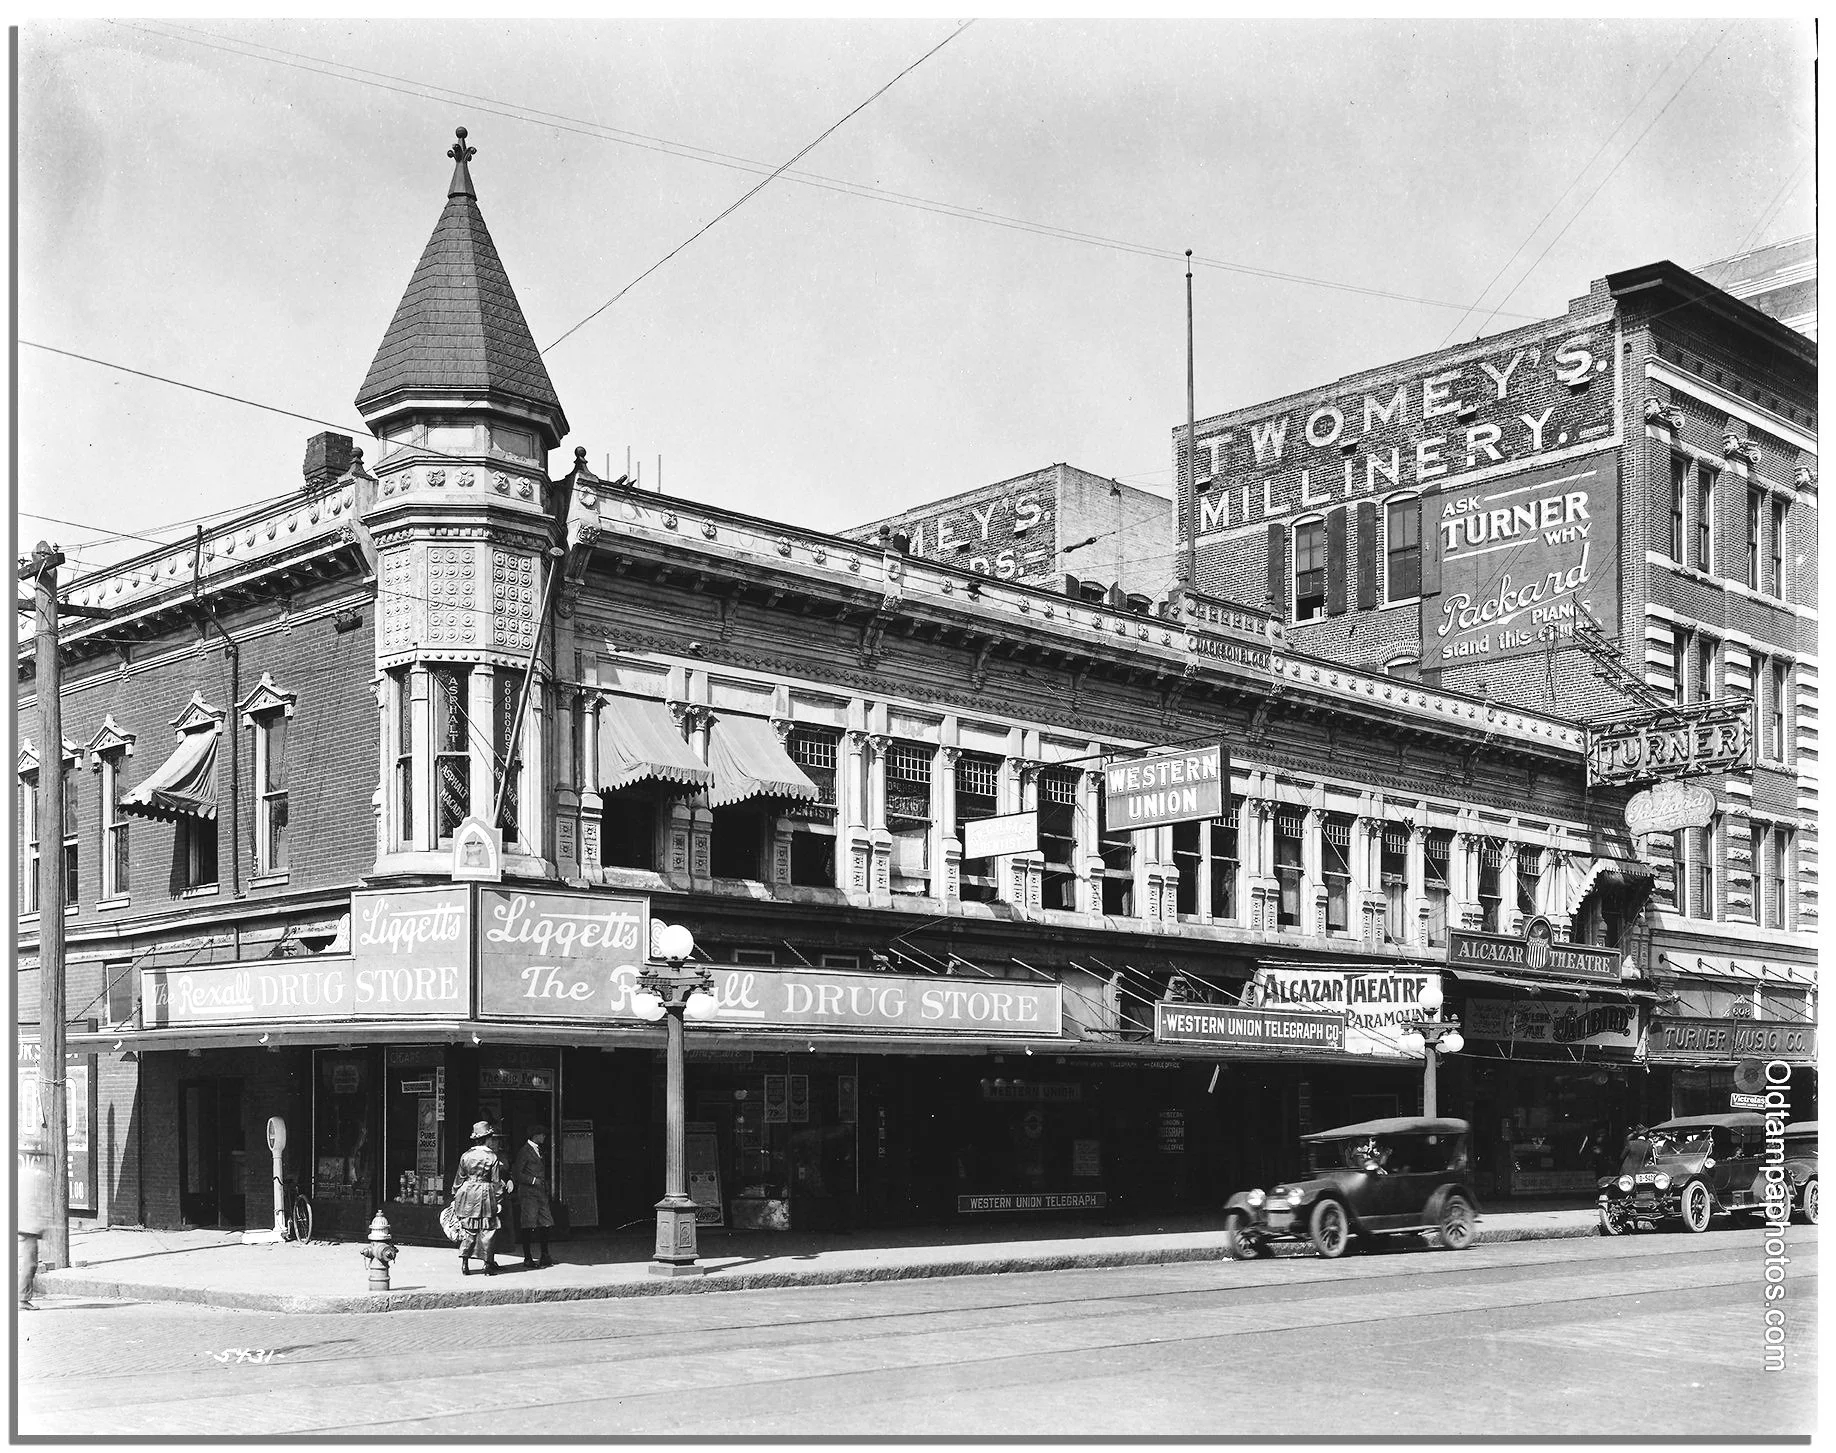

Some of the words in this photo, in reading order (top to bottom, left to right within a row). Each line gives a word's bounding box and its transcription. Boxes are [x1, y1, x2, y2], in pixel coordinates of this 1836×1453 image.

[1199, 407, 1567, 532] MILLINERY.
[1441, 491, 1591, 553] TURNER
[1442, 495, 1482, 518] ASK
[1543, 523, 1593, 547] WHY
[1437, 541, 1591, 637] Packard
[1442, 634, 1490, 660] stand
[1497, 629, 1532, 650] this
[448, 677, 459, 743] ASPHALT
[1600, 725, 1740, 772] TURNER
[442, 764, 469, 799] ASPHALT
[1109, 754, 1217, 793] WESTERN
[439, 788, 465, 820] MACADA
[1128, 787, 1197, 819] UNION
[360, 897, 464, 953] Liggett's
[487, 895, 640, 956] Liggett's
[1458, 941, 1523, 964] ALCAZAR
[1549, 951, 1610, 973] THEATRE
[178, 971, 254, 1014] Rexall
[258, 972, 346, 1006] DRUG
[356, 967, 459, 1003] STORE
[520, 966, 595, 1000] The
[782, 983, 907, 1018] DRUG
[921, 990, 1038, 1022] STORE
[1260, 974, 1343, 1007] ALCAZAR
[1228, 1017, 1261, 1037] UNION
[1264, 1020, 1323, 1040] TELEGRAPH
[1346, 1008, 1425, 1030] PARAMOUN
[1665, 1027, 1726, 1050] TURNER
[1735, 1030, 1777, 1052] MUSIC
[1786, 1032, 1806, 1051] CO.
[419, 1139, 437, 1148] DRUGS
[420, 1131, 436, 1140] PURE
[970, 1197, 1011, 1209] WESTERN
[1016, 1197, 1042, 1208] UNION
[1046, 1195, 1097, 1207] TELEGRAPH
